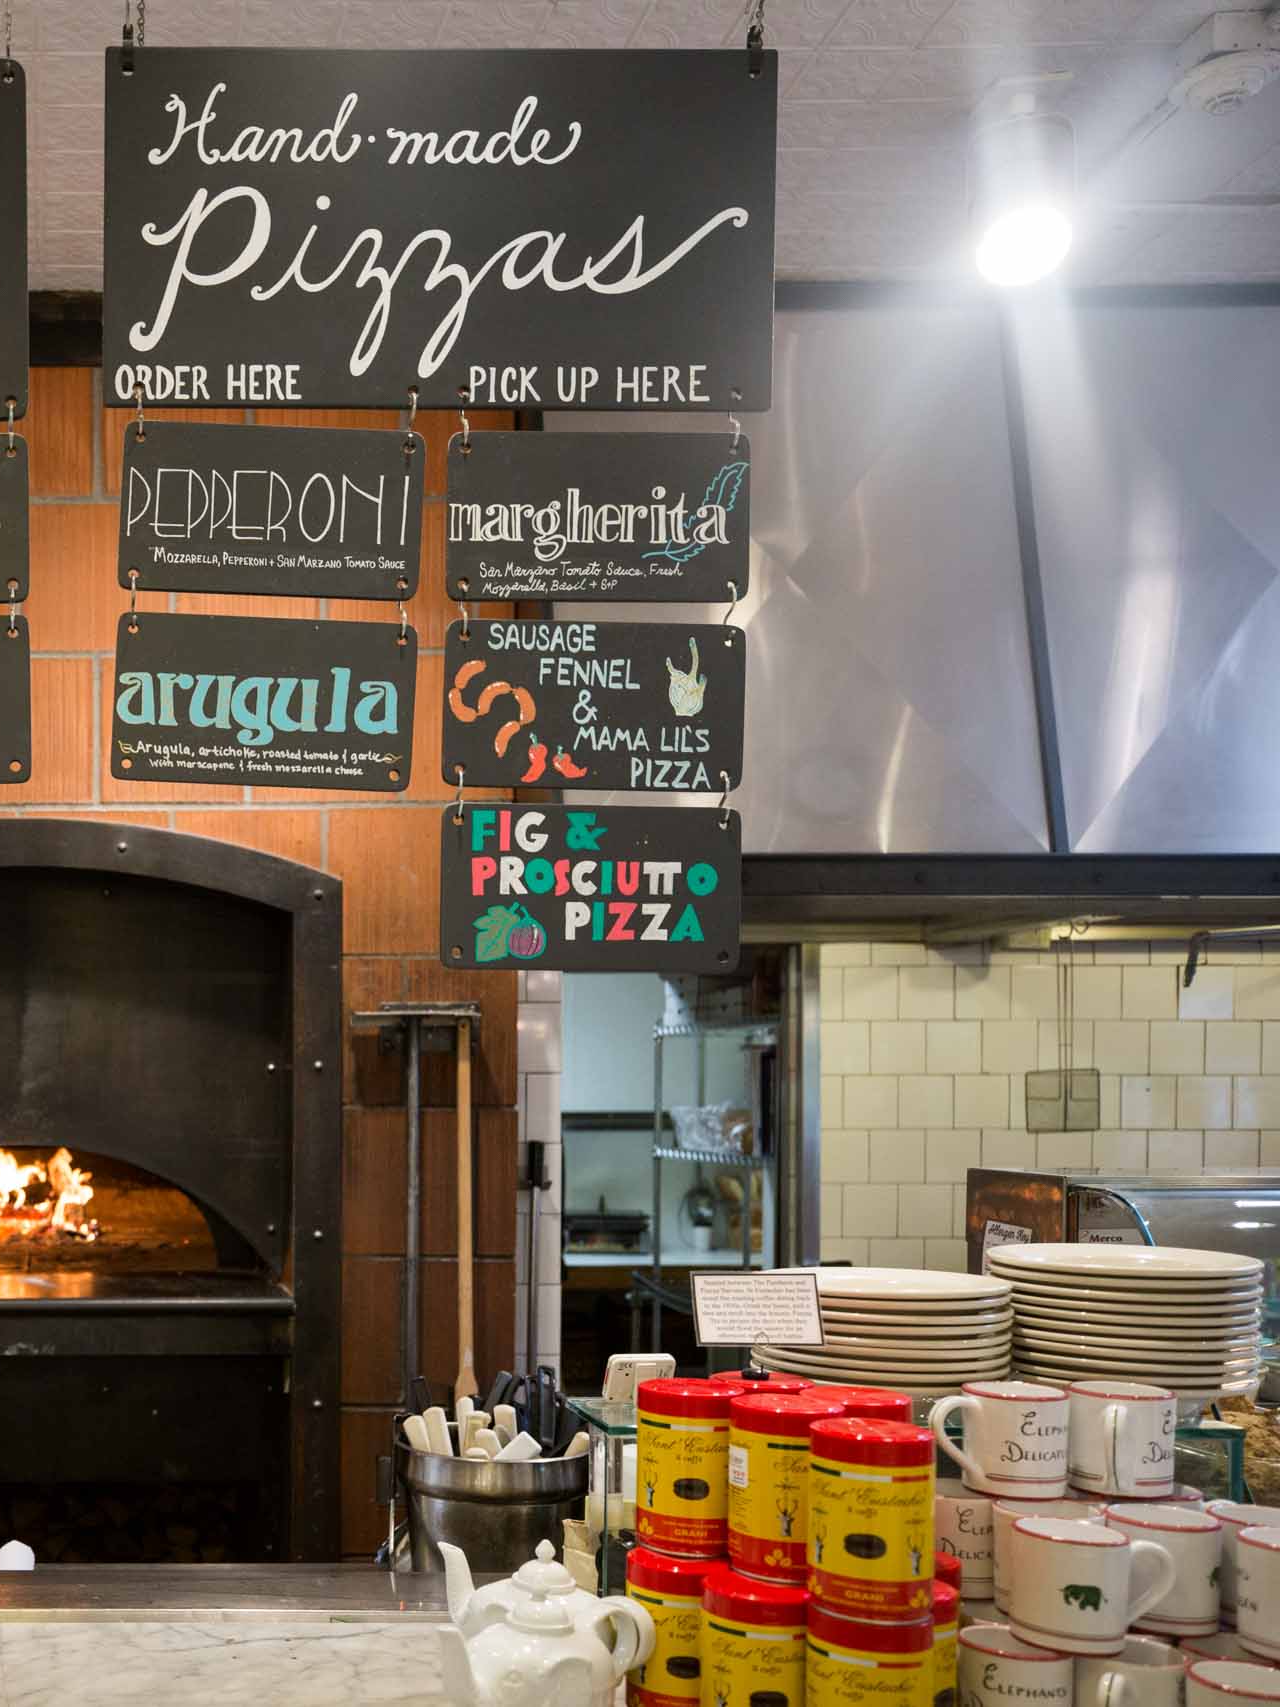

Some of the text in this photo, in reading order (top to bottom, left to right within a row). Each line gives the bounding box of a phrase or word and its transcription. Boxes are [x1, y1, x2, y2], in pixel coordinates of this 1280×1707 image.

[129, 186, 748, 378] Pizzas
[115, 363, 302, 402] ORDER HERE
[469, 365, 710, 403] PICK UP HERE
[126, 466, 410, 545] PEPPERONI
[449, 486, 731, 561] margherita
[479, 561, 502, 578] San
[505, 561, 556, 583] Marzano
[560, 561, 602, 577] Tomato
[649, 562, 684, 577] Fresh
[550, 578, 586, 592] Basil
[488, 623, 597, 652] SAUSAGE
[539, 657, 640, 690] FENNEL
[116, 667, 400, 746] arugula
[572, 689, 598, 724] &
[262, 748, 301, 761] roasted
[303, 750, 339, 761] tomato
[350, 750, 381, 765] garlic
[573, 726, 650, 751] MAMA
[631, 757, 712, 790] PIZZA
[471, 810, 608, 853] FIG &
[471, 856, 719, 896] PROSCIUTTO
[565, 901, 705, 942] PIZZA
